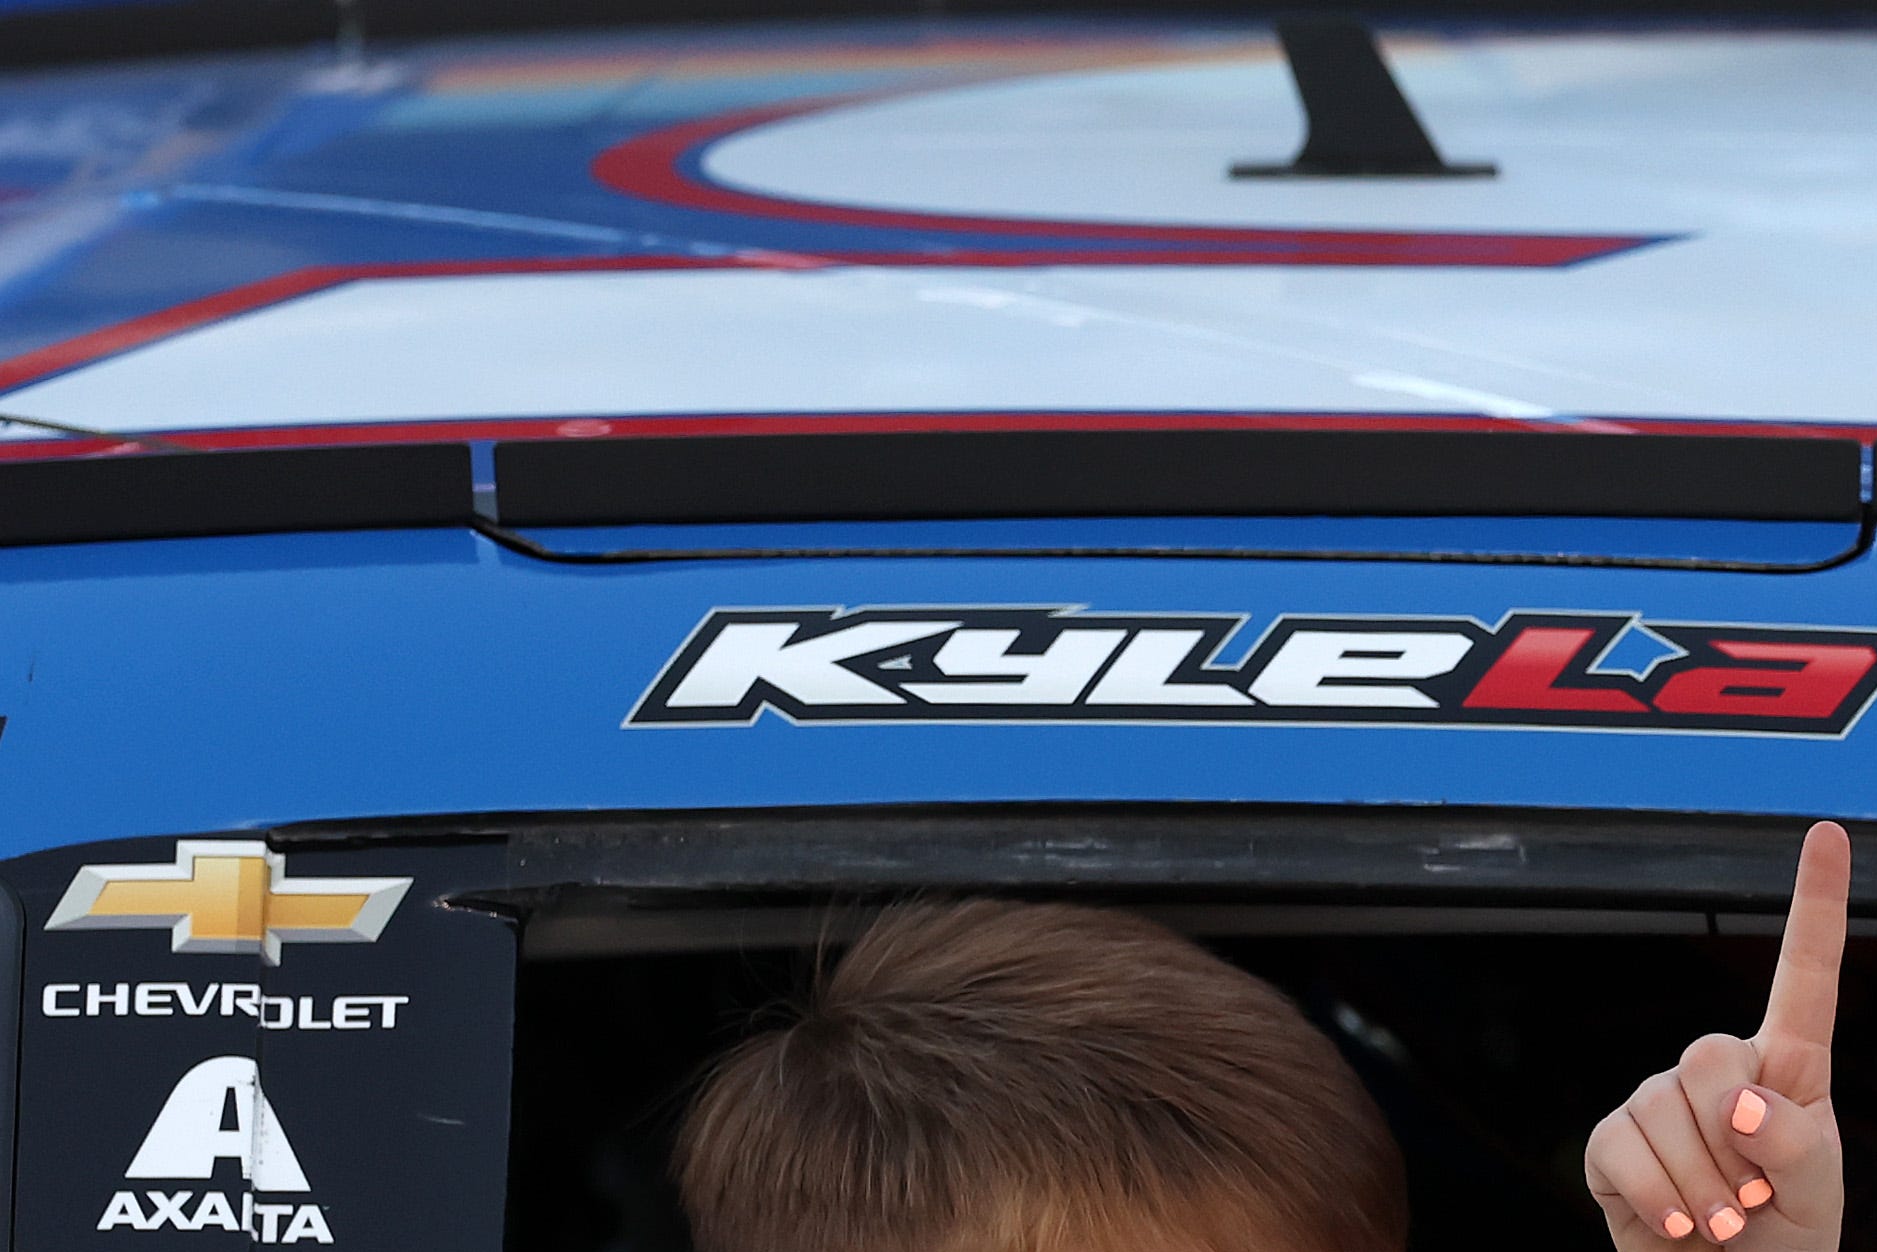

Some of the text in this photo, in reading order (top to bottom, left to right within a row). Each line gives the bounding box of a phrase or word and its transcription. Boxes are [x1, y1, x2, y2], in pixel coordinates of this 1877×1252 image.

[665, 621, 1474, 708] KYLE
[42, 982, 409, 1030] CHEVROLET
[96, 1191, 335, 1244] AXALTA
